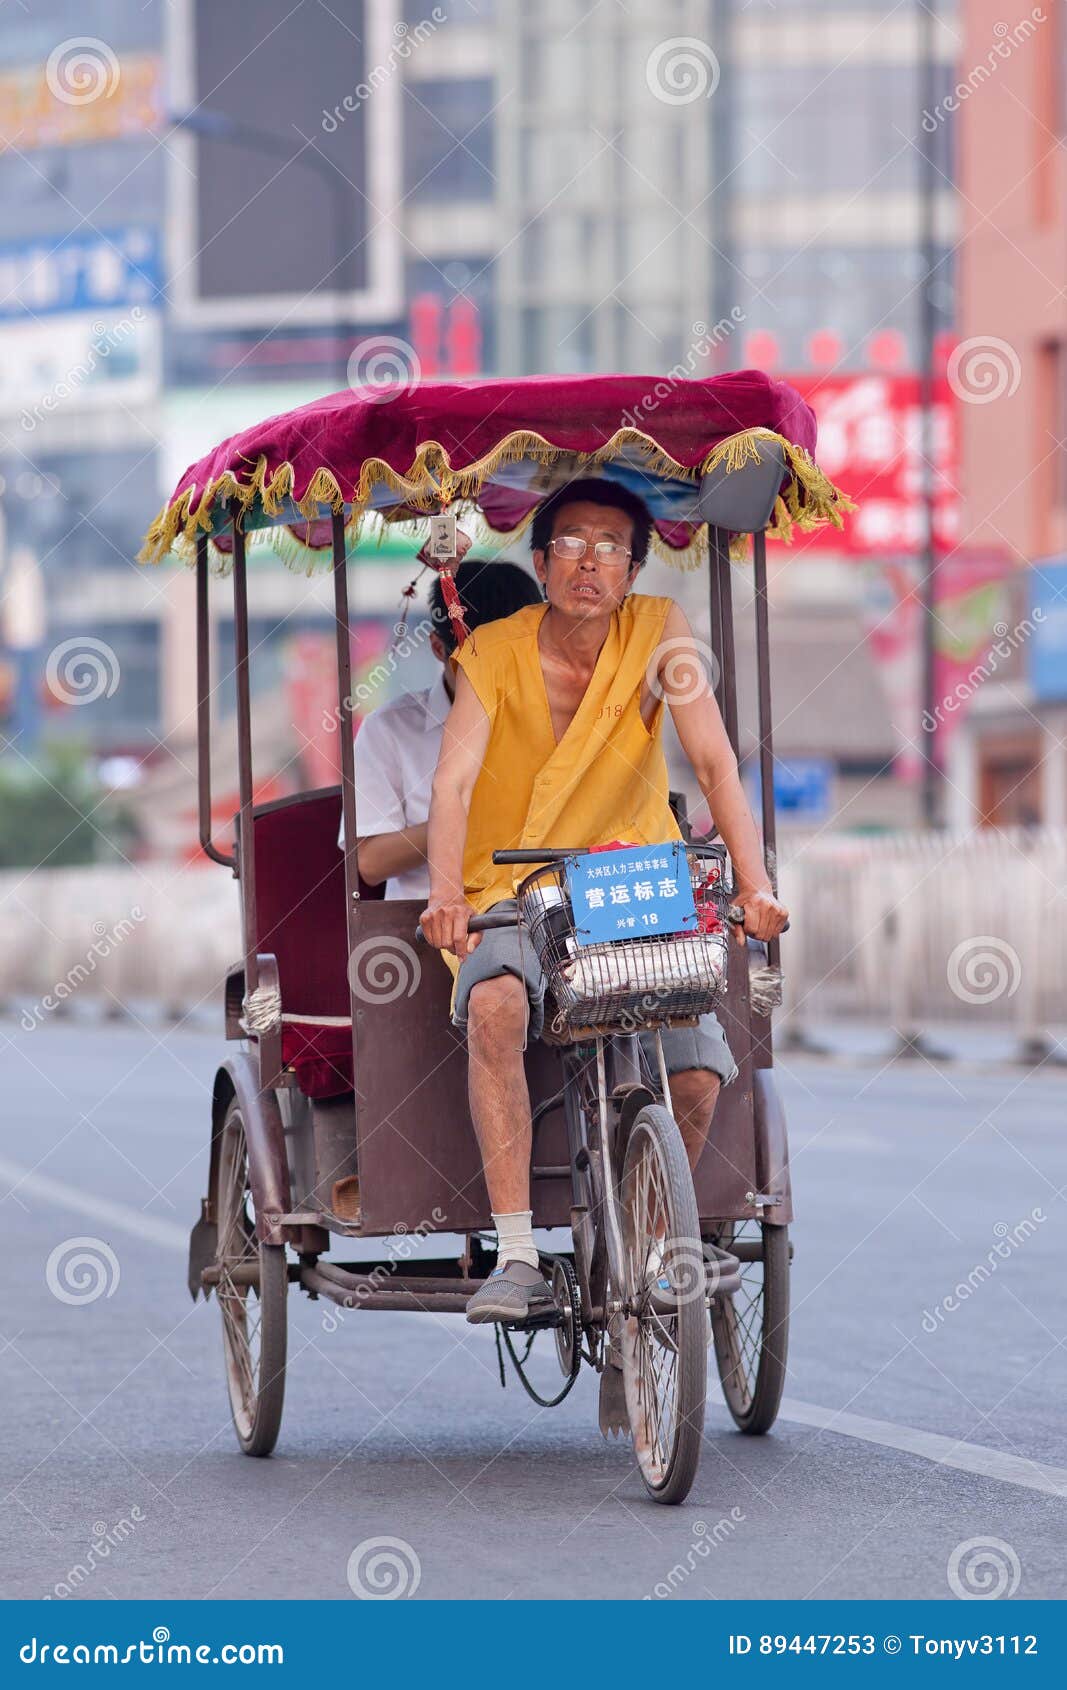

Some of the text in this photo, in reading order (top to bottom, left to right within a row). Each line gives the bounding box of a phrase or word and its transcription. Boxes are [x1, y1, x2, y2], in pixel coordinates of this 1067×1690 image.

[587, 858, 669, 879] 大兴区人力三轮车客运
[585, 877, 679, 909] 营运标志
[642, 913, 658, 926] 18
